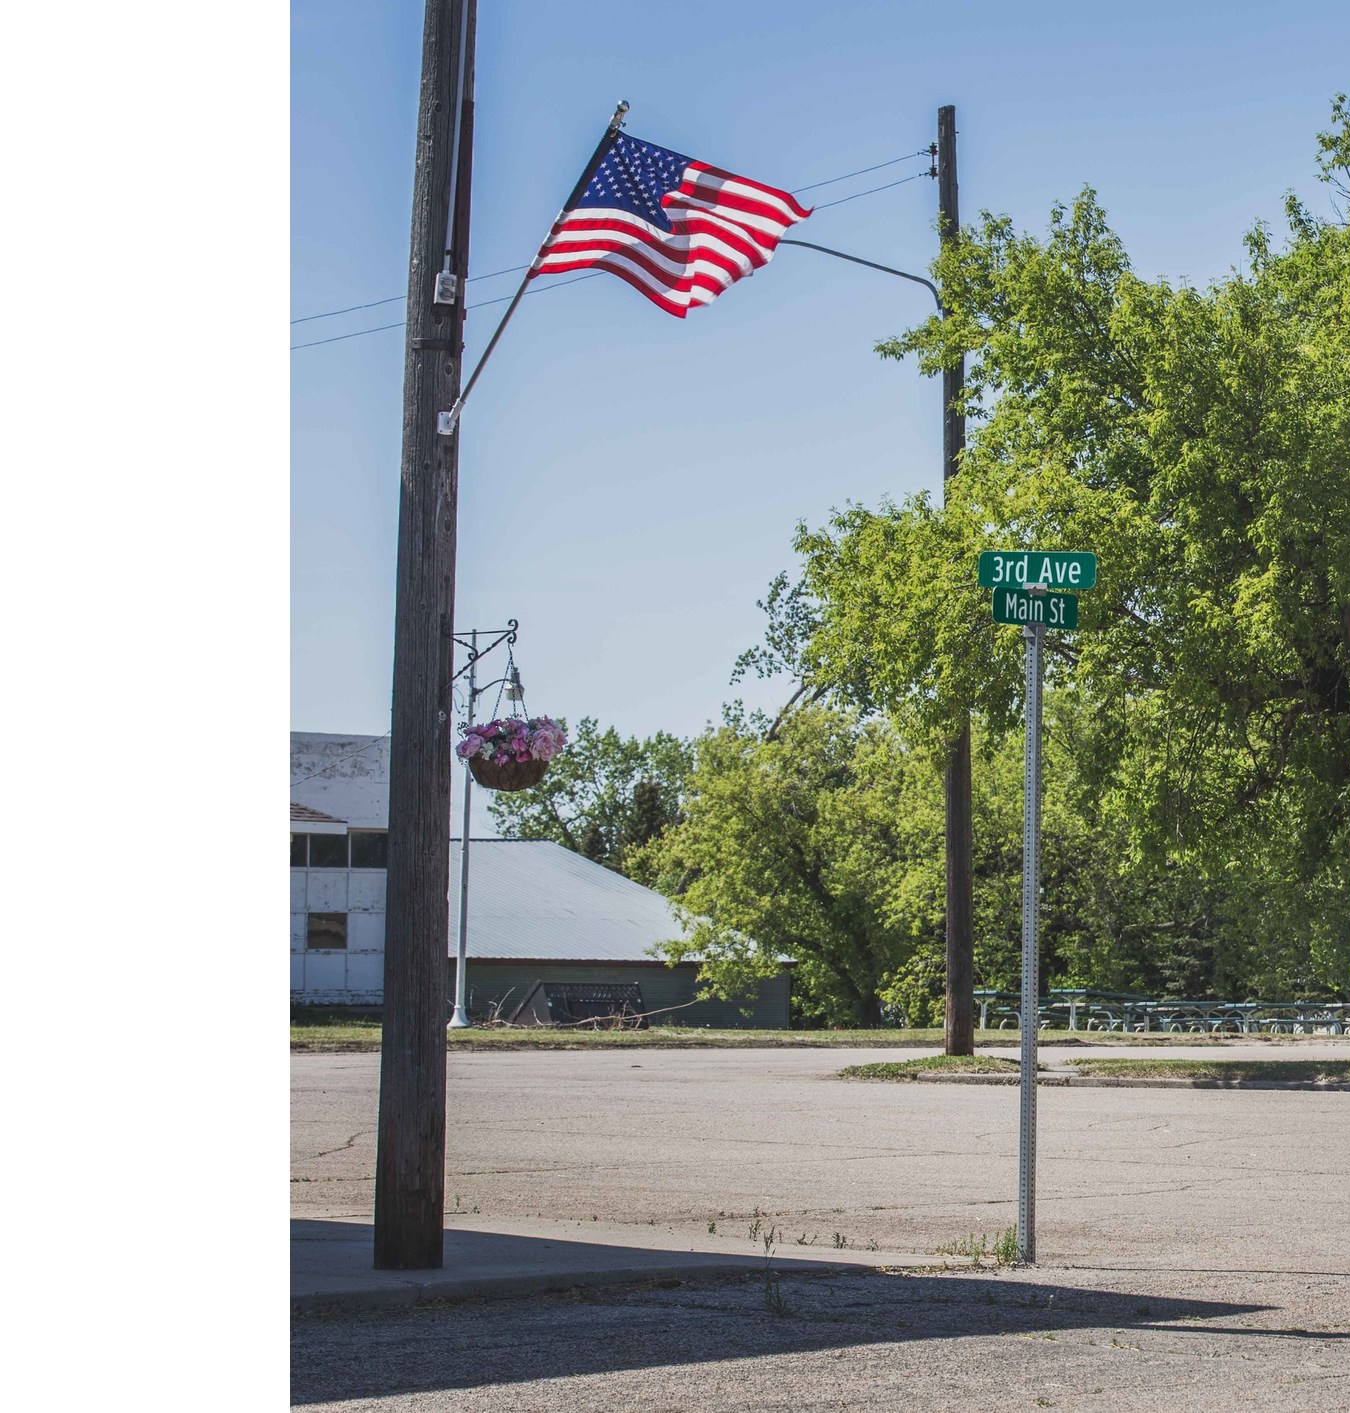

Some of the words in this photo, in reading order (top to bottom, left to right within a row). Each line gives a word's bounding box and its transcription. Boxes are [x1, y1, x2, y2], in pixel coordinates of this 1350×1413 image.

[992, 555, 1028, 582] 3rd
[1039, 557, 1081, 584] Ave
[1005, 592, 1043, 622] Main
[1049, 597, 1065, 624] St
